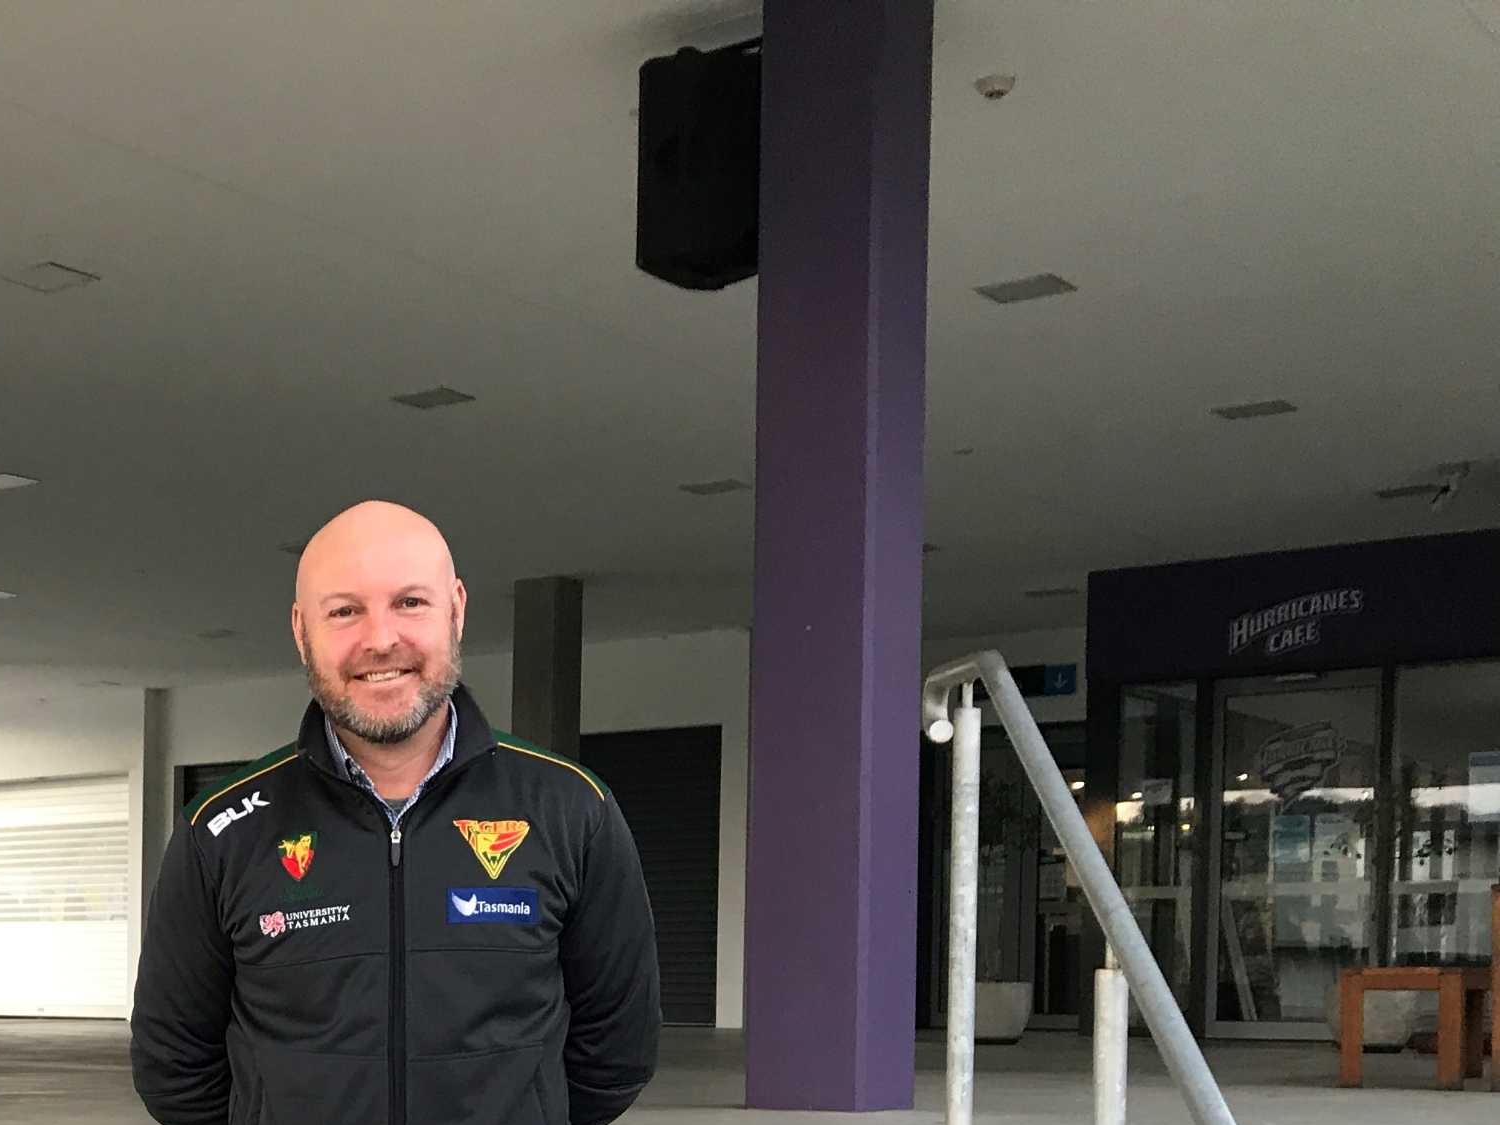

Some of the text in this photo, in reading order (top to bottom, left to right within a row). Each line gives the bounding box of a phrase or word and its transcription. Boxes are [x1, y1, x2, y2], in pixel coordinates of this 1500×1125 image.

[1230, 588, 1363, 652] HURRICANES
[1267, 621, 1320, 654] CAFE
[207, 791, 271, 837] BLK
[285, 906, 342, 921] UNIVERSITY
[477, 900, 530, 915] Tasmania
[286, 913, 350, 929] TASMANIA
